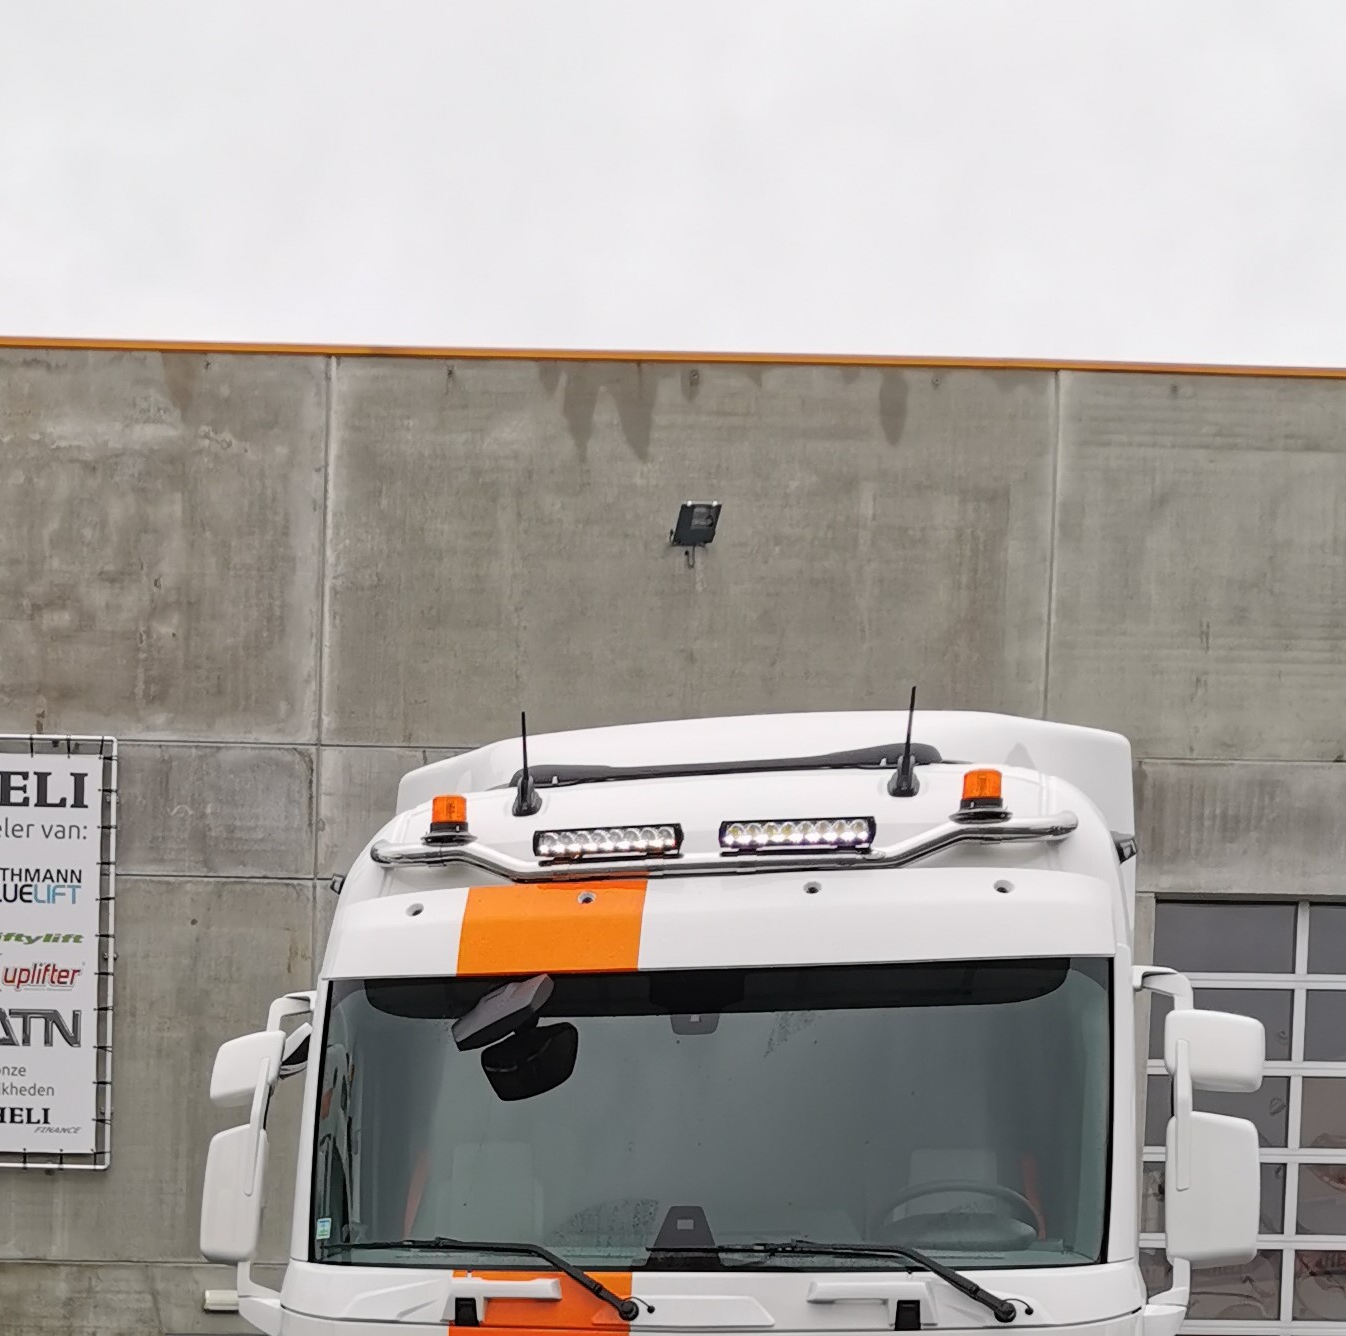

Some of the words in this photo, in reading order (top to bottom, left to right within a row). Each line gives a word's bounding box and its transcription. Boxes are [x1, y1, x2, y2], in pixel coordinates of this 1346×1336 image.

[41, 822, 88, 840] van:
[2, 963, 82, 990] uplifter
[33, 1126, 82, 1134] FINANCE
